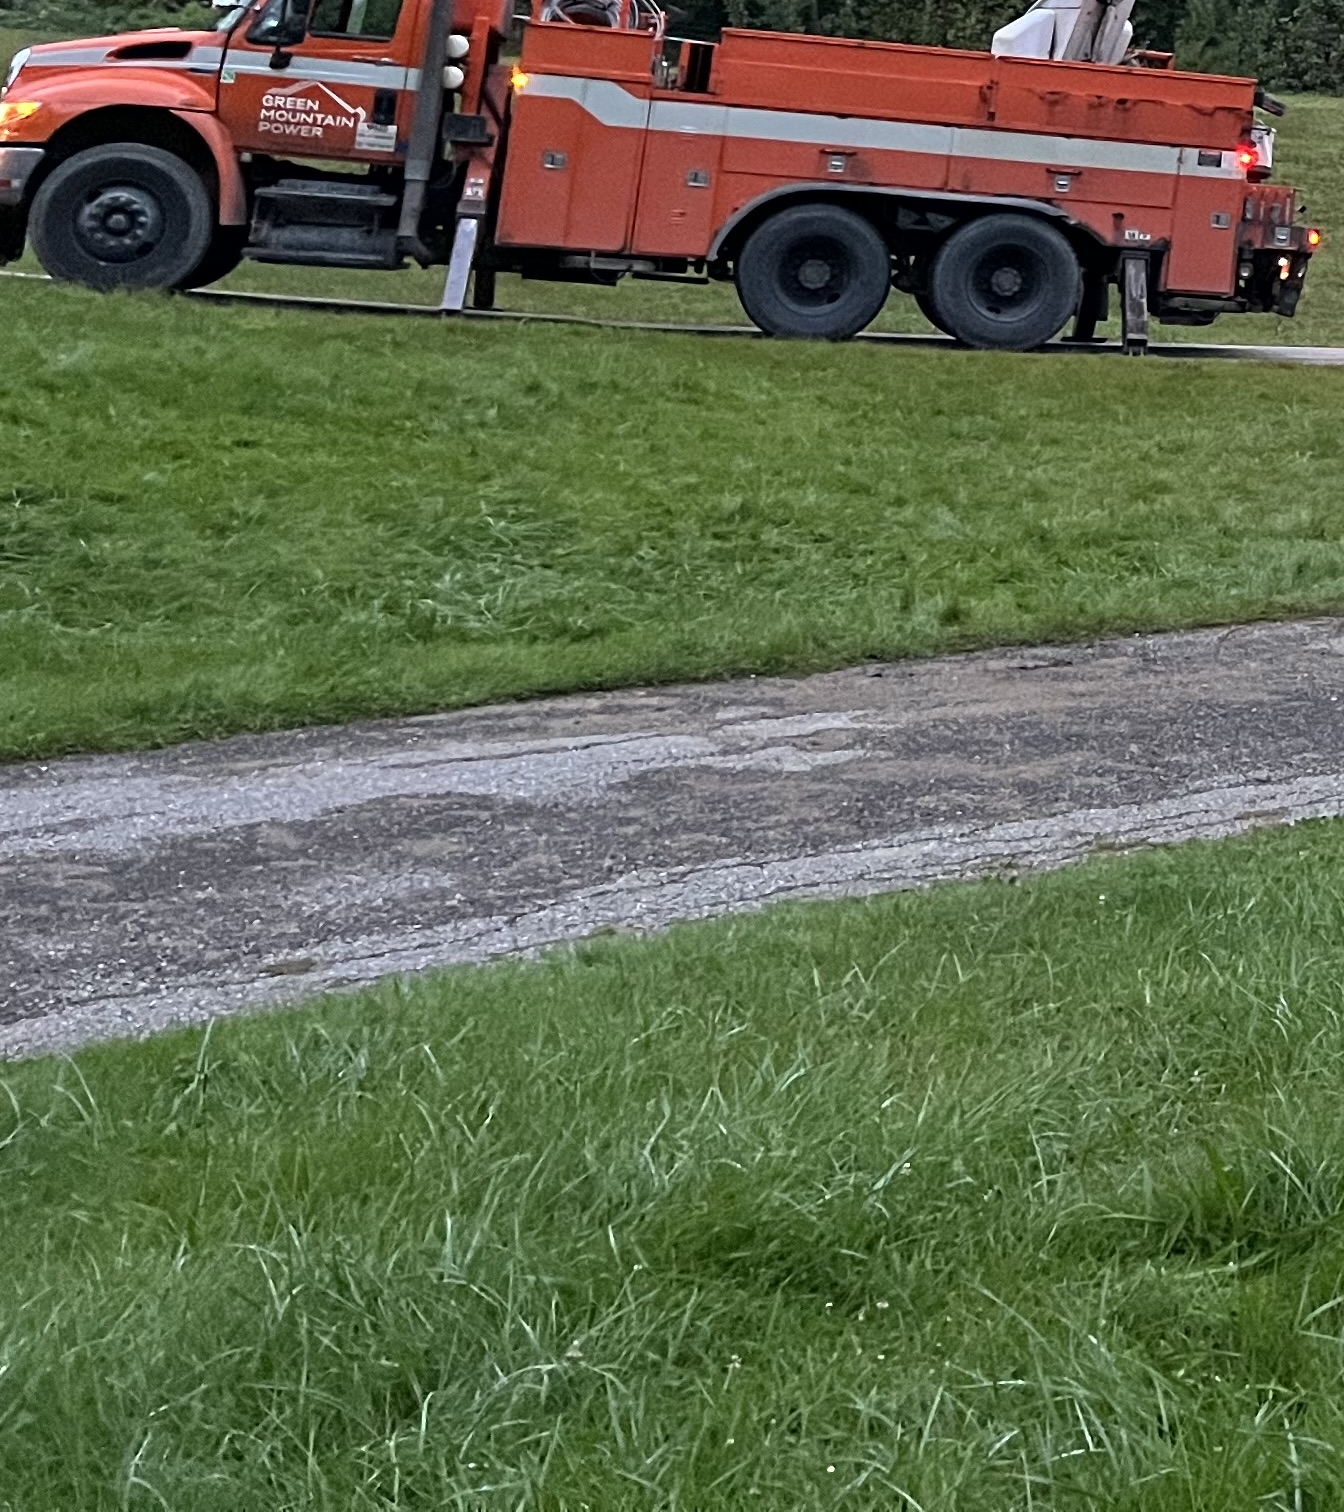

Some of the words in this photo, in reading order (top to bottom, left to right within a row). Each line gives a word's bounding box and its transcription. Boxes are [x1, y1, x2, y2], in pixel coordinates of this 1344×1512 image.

[262, 95, 319, 111] GREEN
[260, 109, 354, 128] MOUNTAIN
[258, 122, 324, 138] POWER
